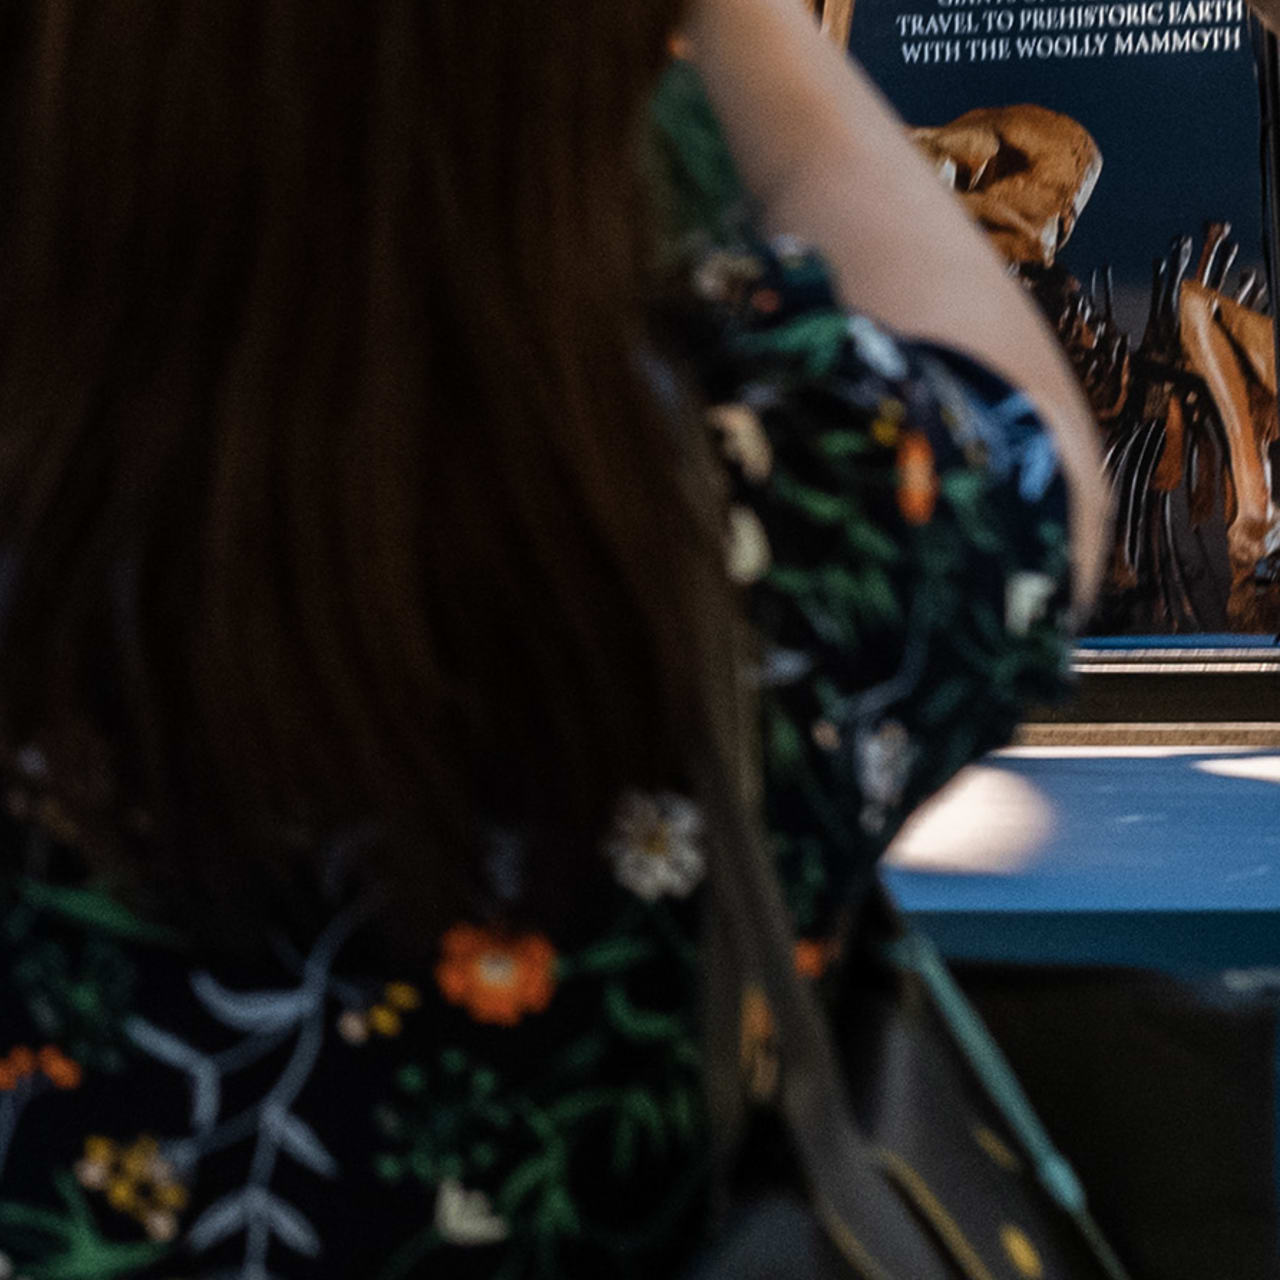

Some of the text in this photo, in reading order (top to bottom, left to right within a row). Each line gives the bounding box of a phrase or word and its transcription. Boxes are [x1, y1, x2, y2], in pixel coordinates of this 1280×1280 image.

[896, 11, 981, 38] TRAVEL
[982, 9, 1015, 34] TO
[1019, 1, 1164, 31] PREHISTORIC
[901, 27, 1241, 65] WITH THE WOOLLY MAMMOTH
